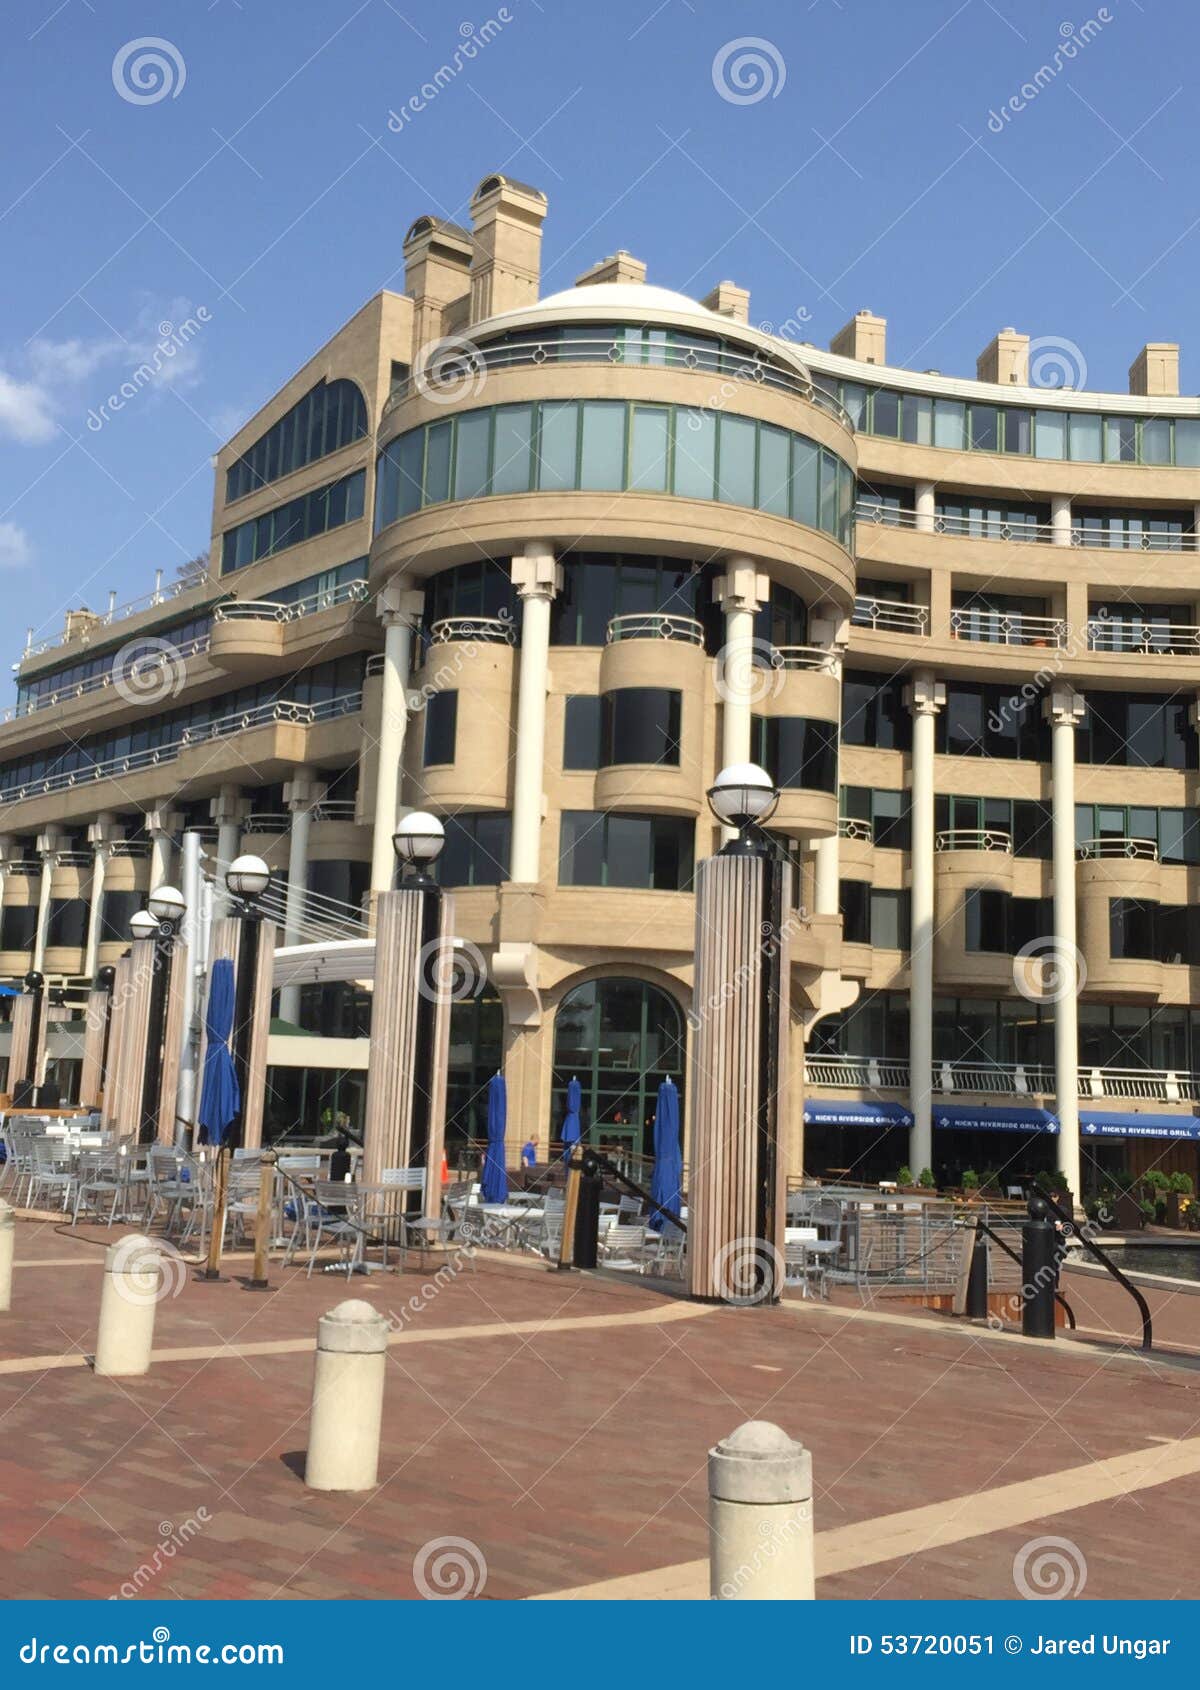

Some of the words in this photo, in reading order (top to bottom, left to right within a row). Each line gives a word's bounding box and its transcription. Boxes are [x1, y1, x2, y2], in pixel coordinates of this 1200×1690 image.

[815, 1114, 837, 1122] NICK'S
[839, 1115, 874, 1123] RIVERSIDE
[875, 1116, 897, 1125] GRILL
[954, 1120, 979, 1128] NICK'S
[980, 1121, 1018, 1129] RIVERSIDE
[1019, 1122, 1041, 1130] GRILL
[1102, 1126, 1127, 1134] NICK'S
[1128, 1127, 1168, 1136] RIVERSIDE
[1169, 1129, 1192, 1137] GRILL
